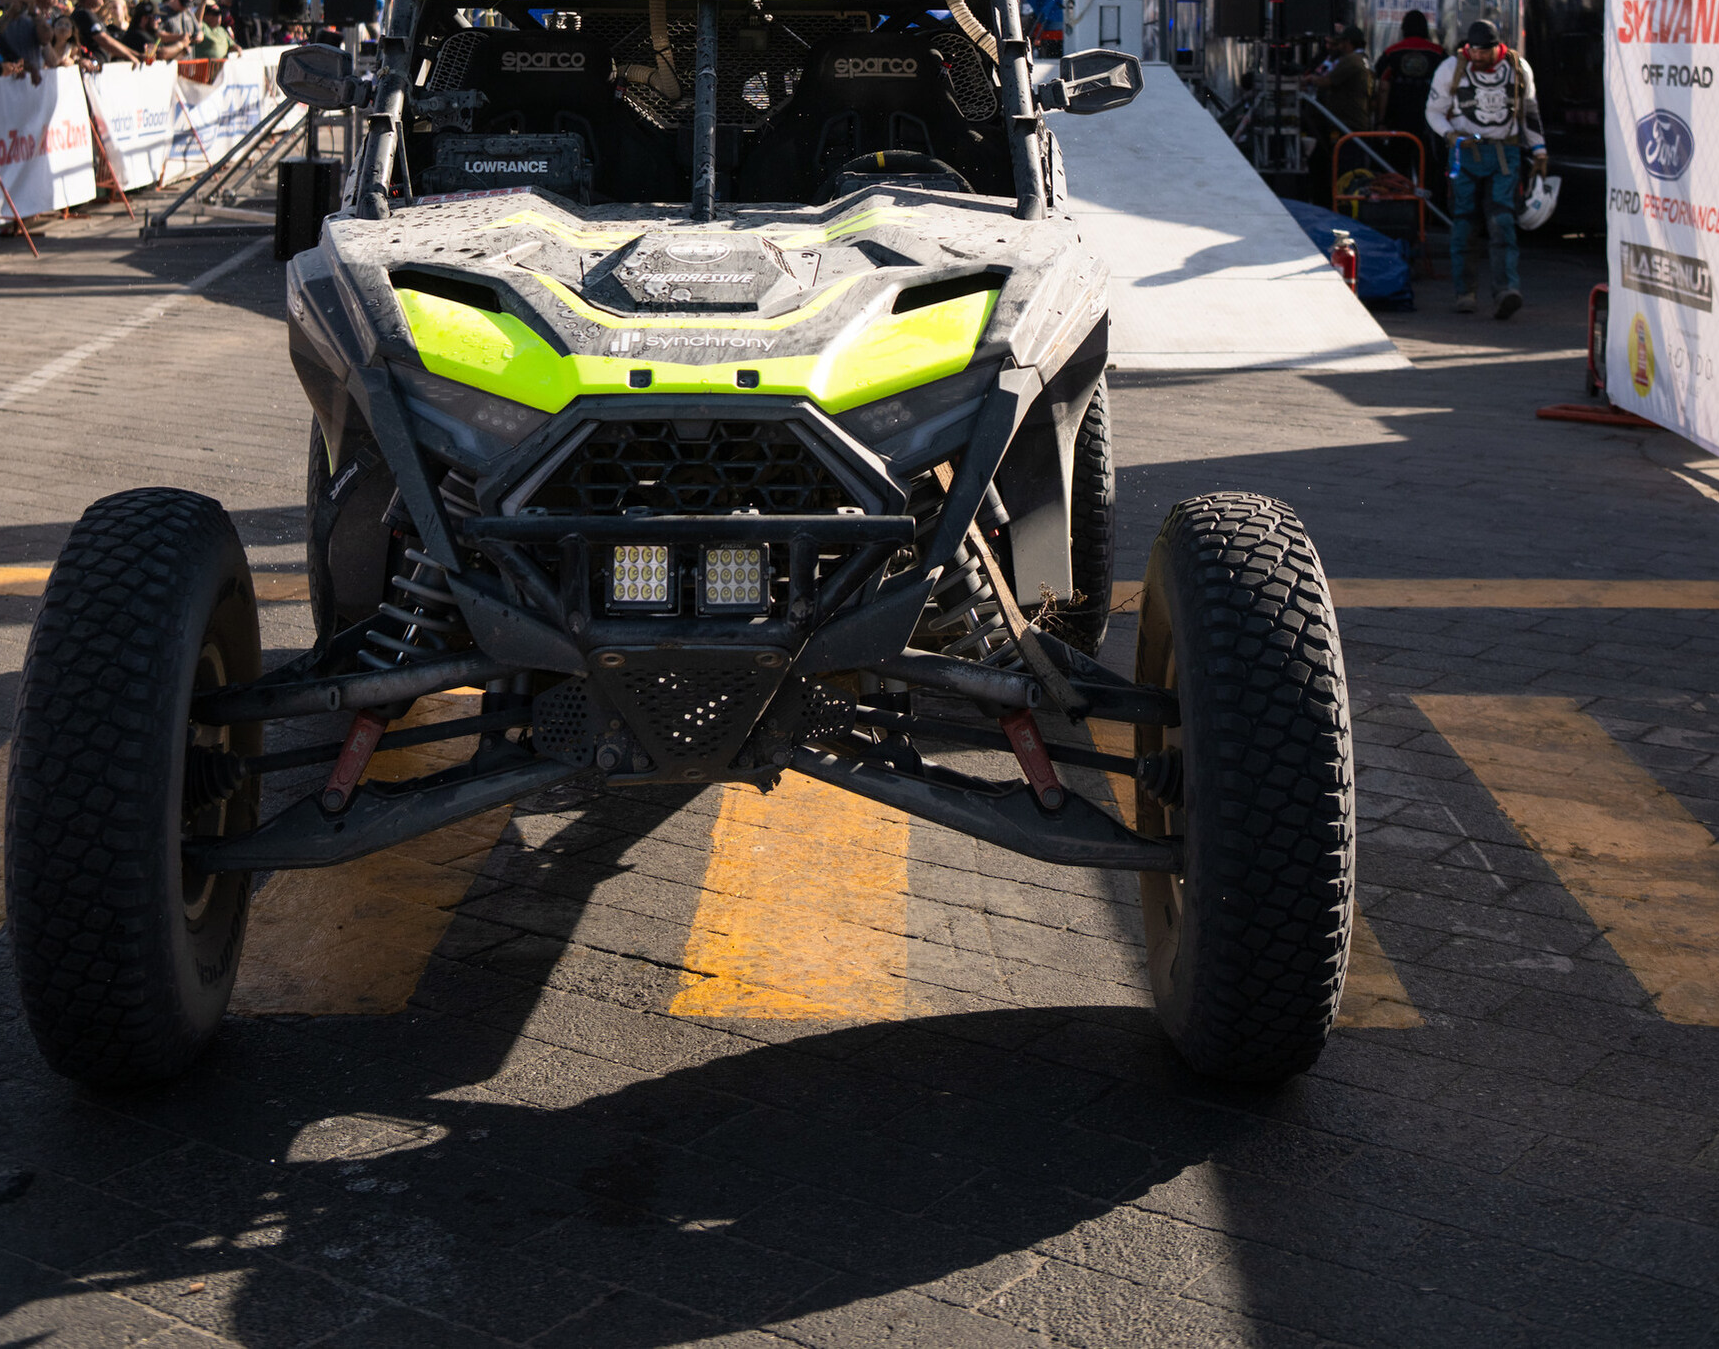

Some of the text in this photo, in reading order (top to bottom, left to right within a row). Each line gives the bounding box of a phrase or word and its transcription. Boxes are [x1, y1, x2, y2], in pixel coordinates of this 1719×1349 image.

[501, 51, 585, 72] sparco
[834, 57, 918, 79] sparco
[1641, 63, 1713, 88] OFF ROAD
[464, 161, 548, 173] LOWRANCE
[1608, 187, 1640, 215] FORD
[637, 273, 756, 284] PROGRESSIVE
[646, 332, 778, 351] synchrony
